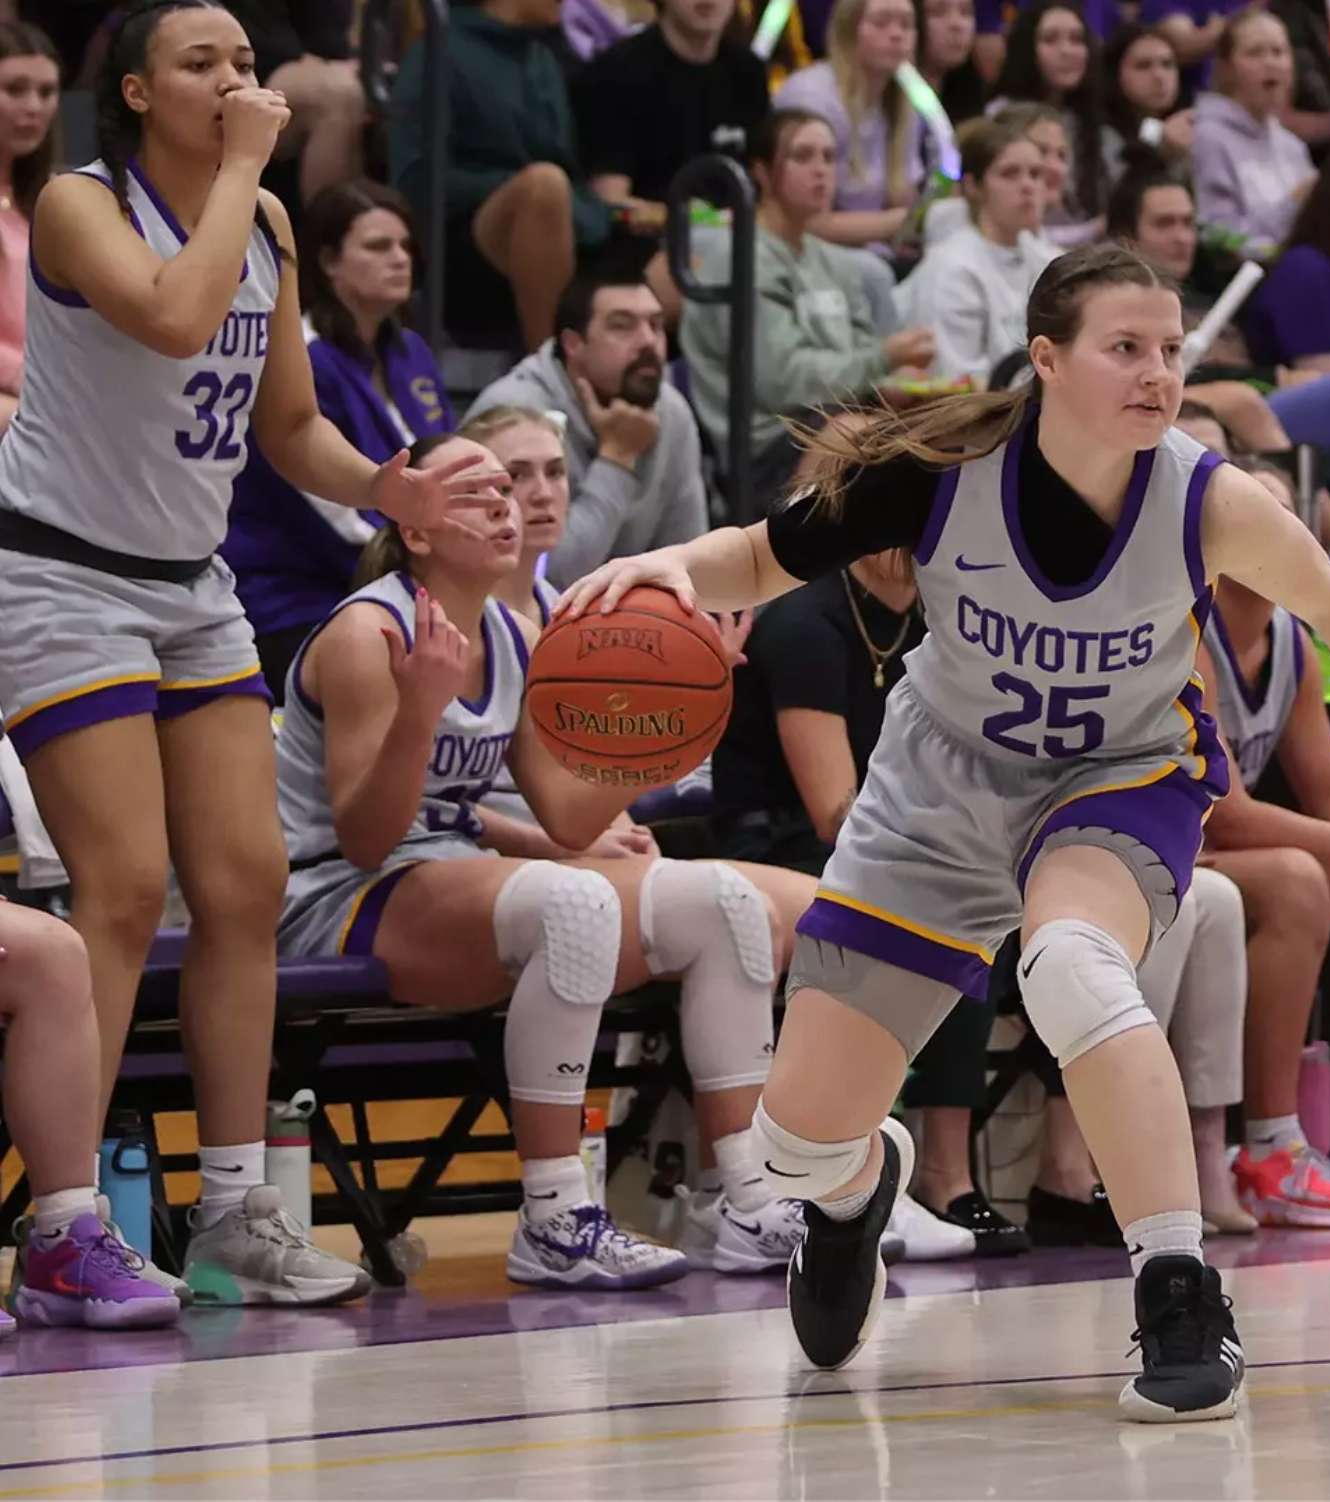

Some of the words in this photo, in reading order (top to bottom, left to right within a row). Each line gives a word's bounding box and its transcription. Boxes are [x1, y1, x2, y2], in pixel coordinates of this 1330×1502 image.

[175, 371, 253, 460] 32
[577, 627, 667, 665] NAIA
[958, 594, 1154, 674] COYOTES
[555, 702, 686, 737] SPALDING
[982, 671, 1110, 759] 25
